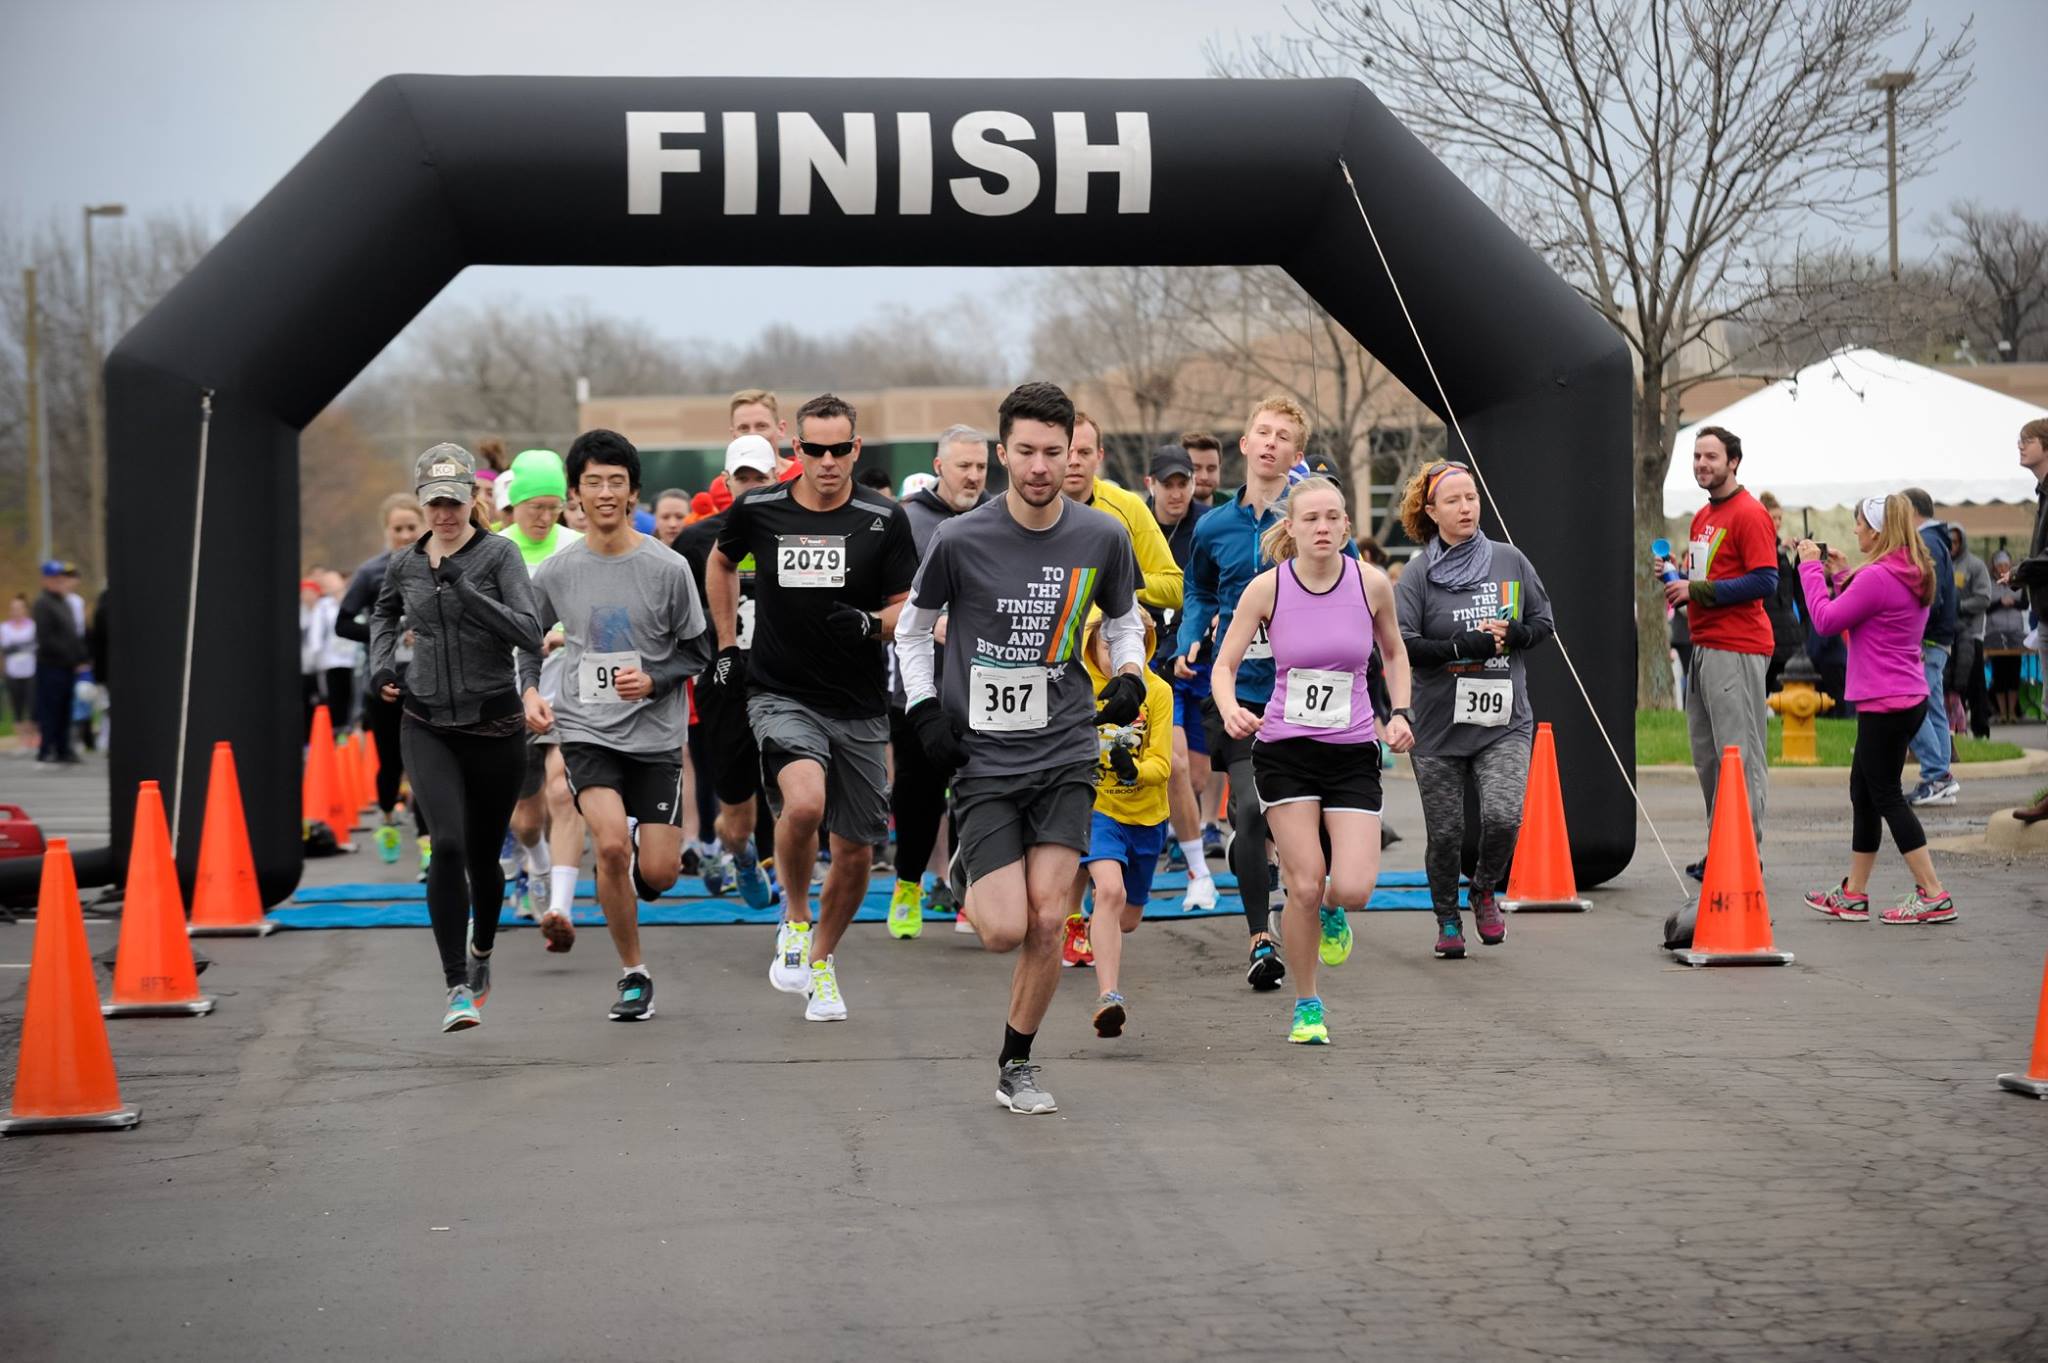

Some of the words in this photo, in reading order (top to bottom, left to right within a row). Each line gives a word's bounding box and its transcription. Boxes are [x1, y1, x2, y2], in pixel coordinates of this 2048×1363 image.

[625, 110, 1152, 216] FINISH
[783, 549, 841, 571] 2079
[1042, 566, 1065, 582] TO
[1027, 582, 1061, 599] THE
[1480, 582, 1498, 593] TO
[996, 598, 1057, 615] FINISH
[1472, 594, 1499, 606] THE
[1452, 605, 1497, 623] FINISH
[1010, 615, 1052, 631] LINE
[1007, 631, 1046, 647] AND
[976, 637, 1042, 662] BEYOND
[984, 683, 1034, 714] 367
[1305, 684, 1334, 712] 87
[1466, 691, 1503, 714] 309
